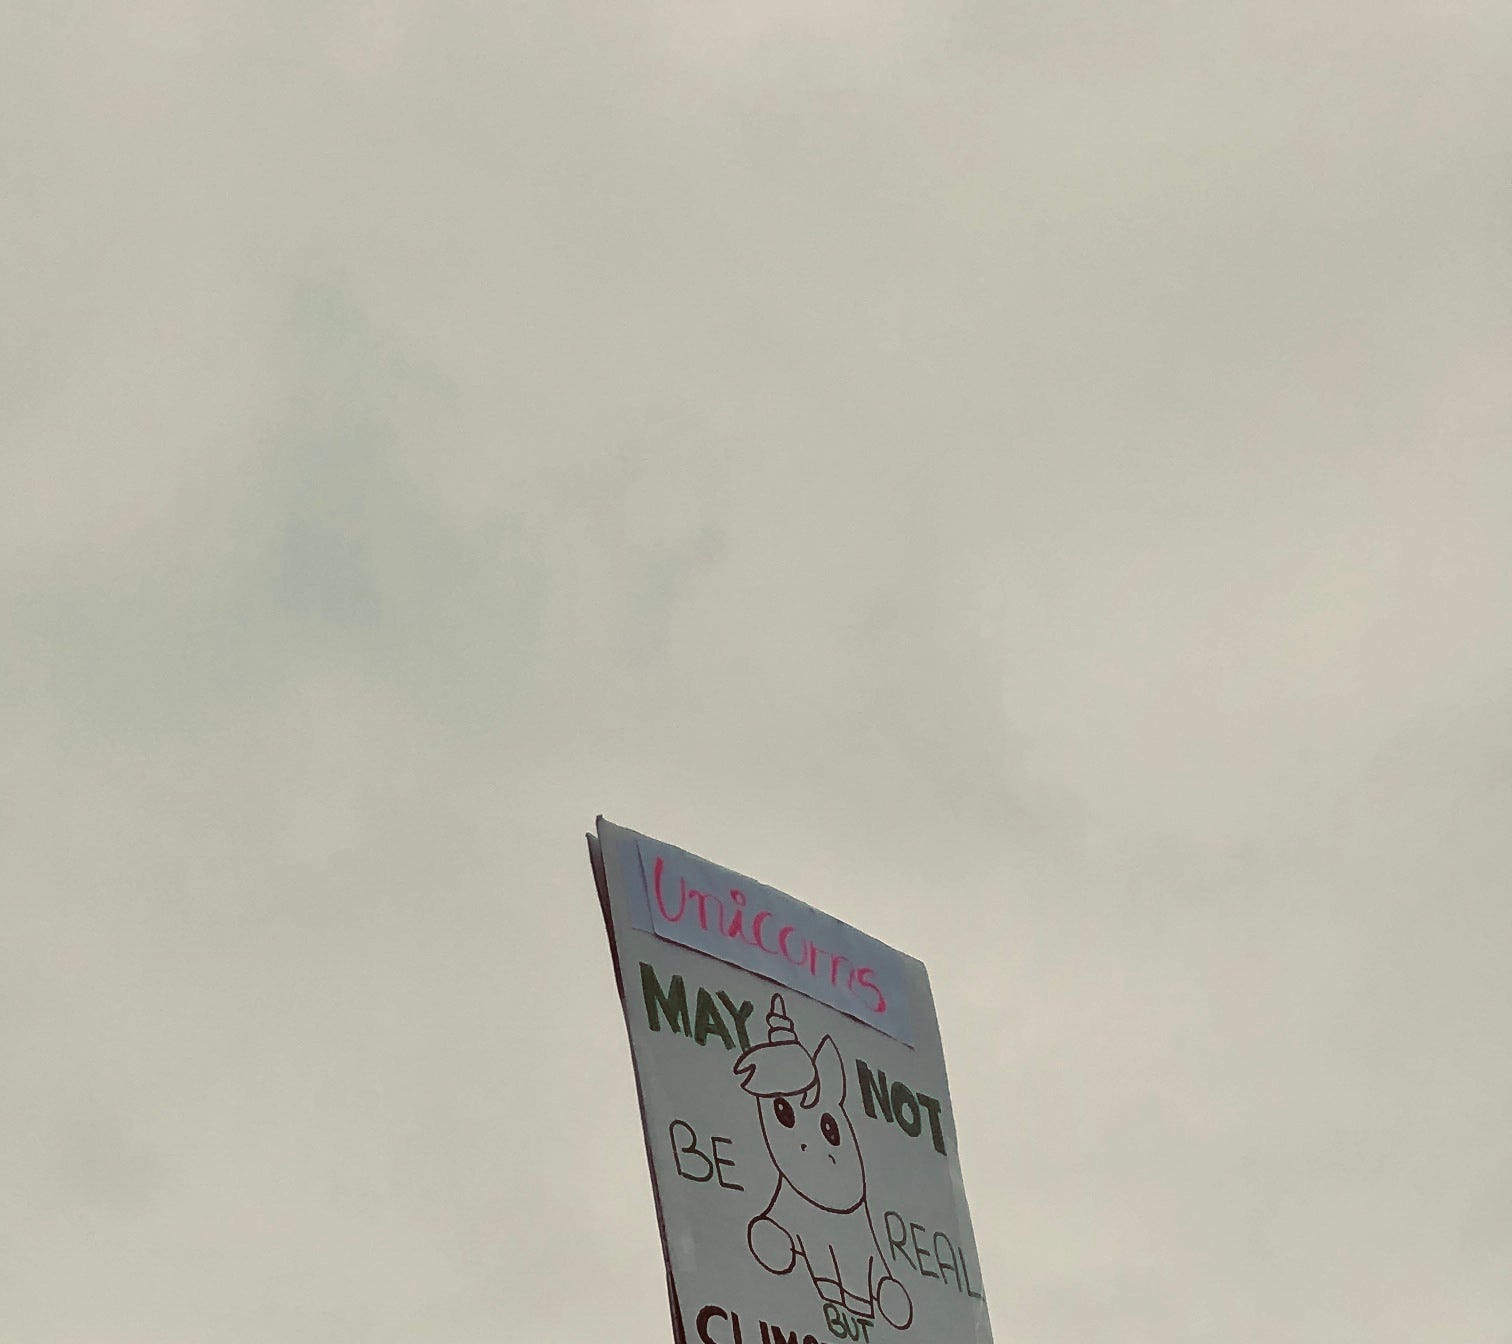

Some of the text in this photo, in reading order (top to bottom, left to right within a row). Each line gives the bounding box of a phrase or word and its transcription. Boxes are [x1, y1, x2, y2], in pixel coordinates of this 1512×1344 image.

[639, 963, 947, 1157] MAY NOT
[668, 1119, 984, 1300] BE REAL
[823, 1302, 876, 1344] BUT
